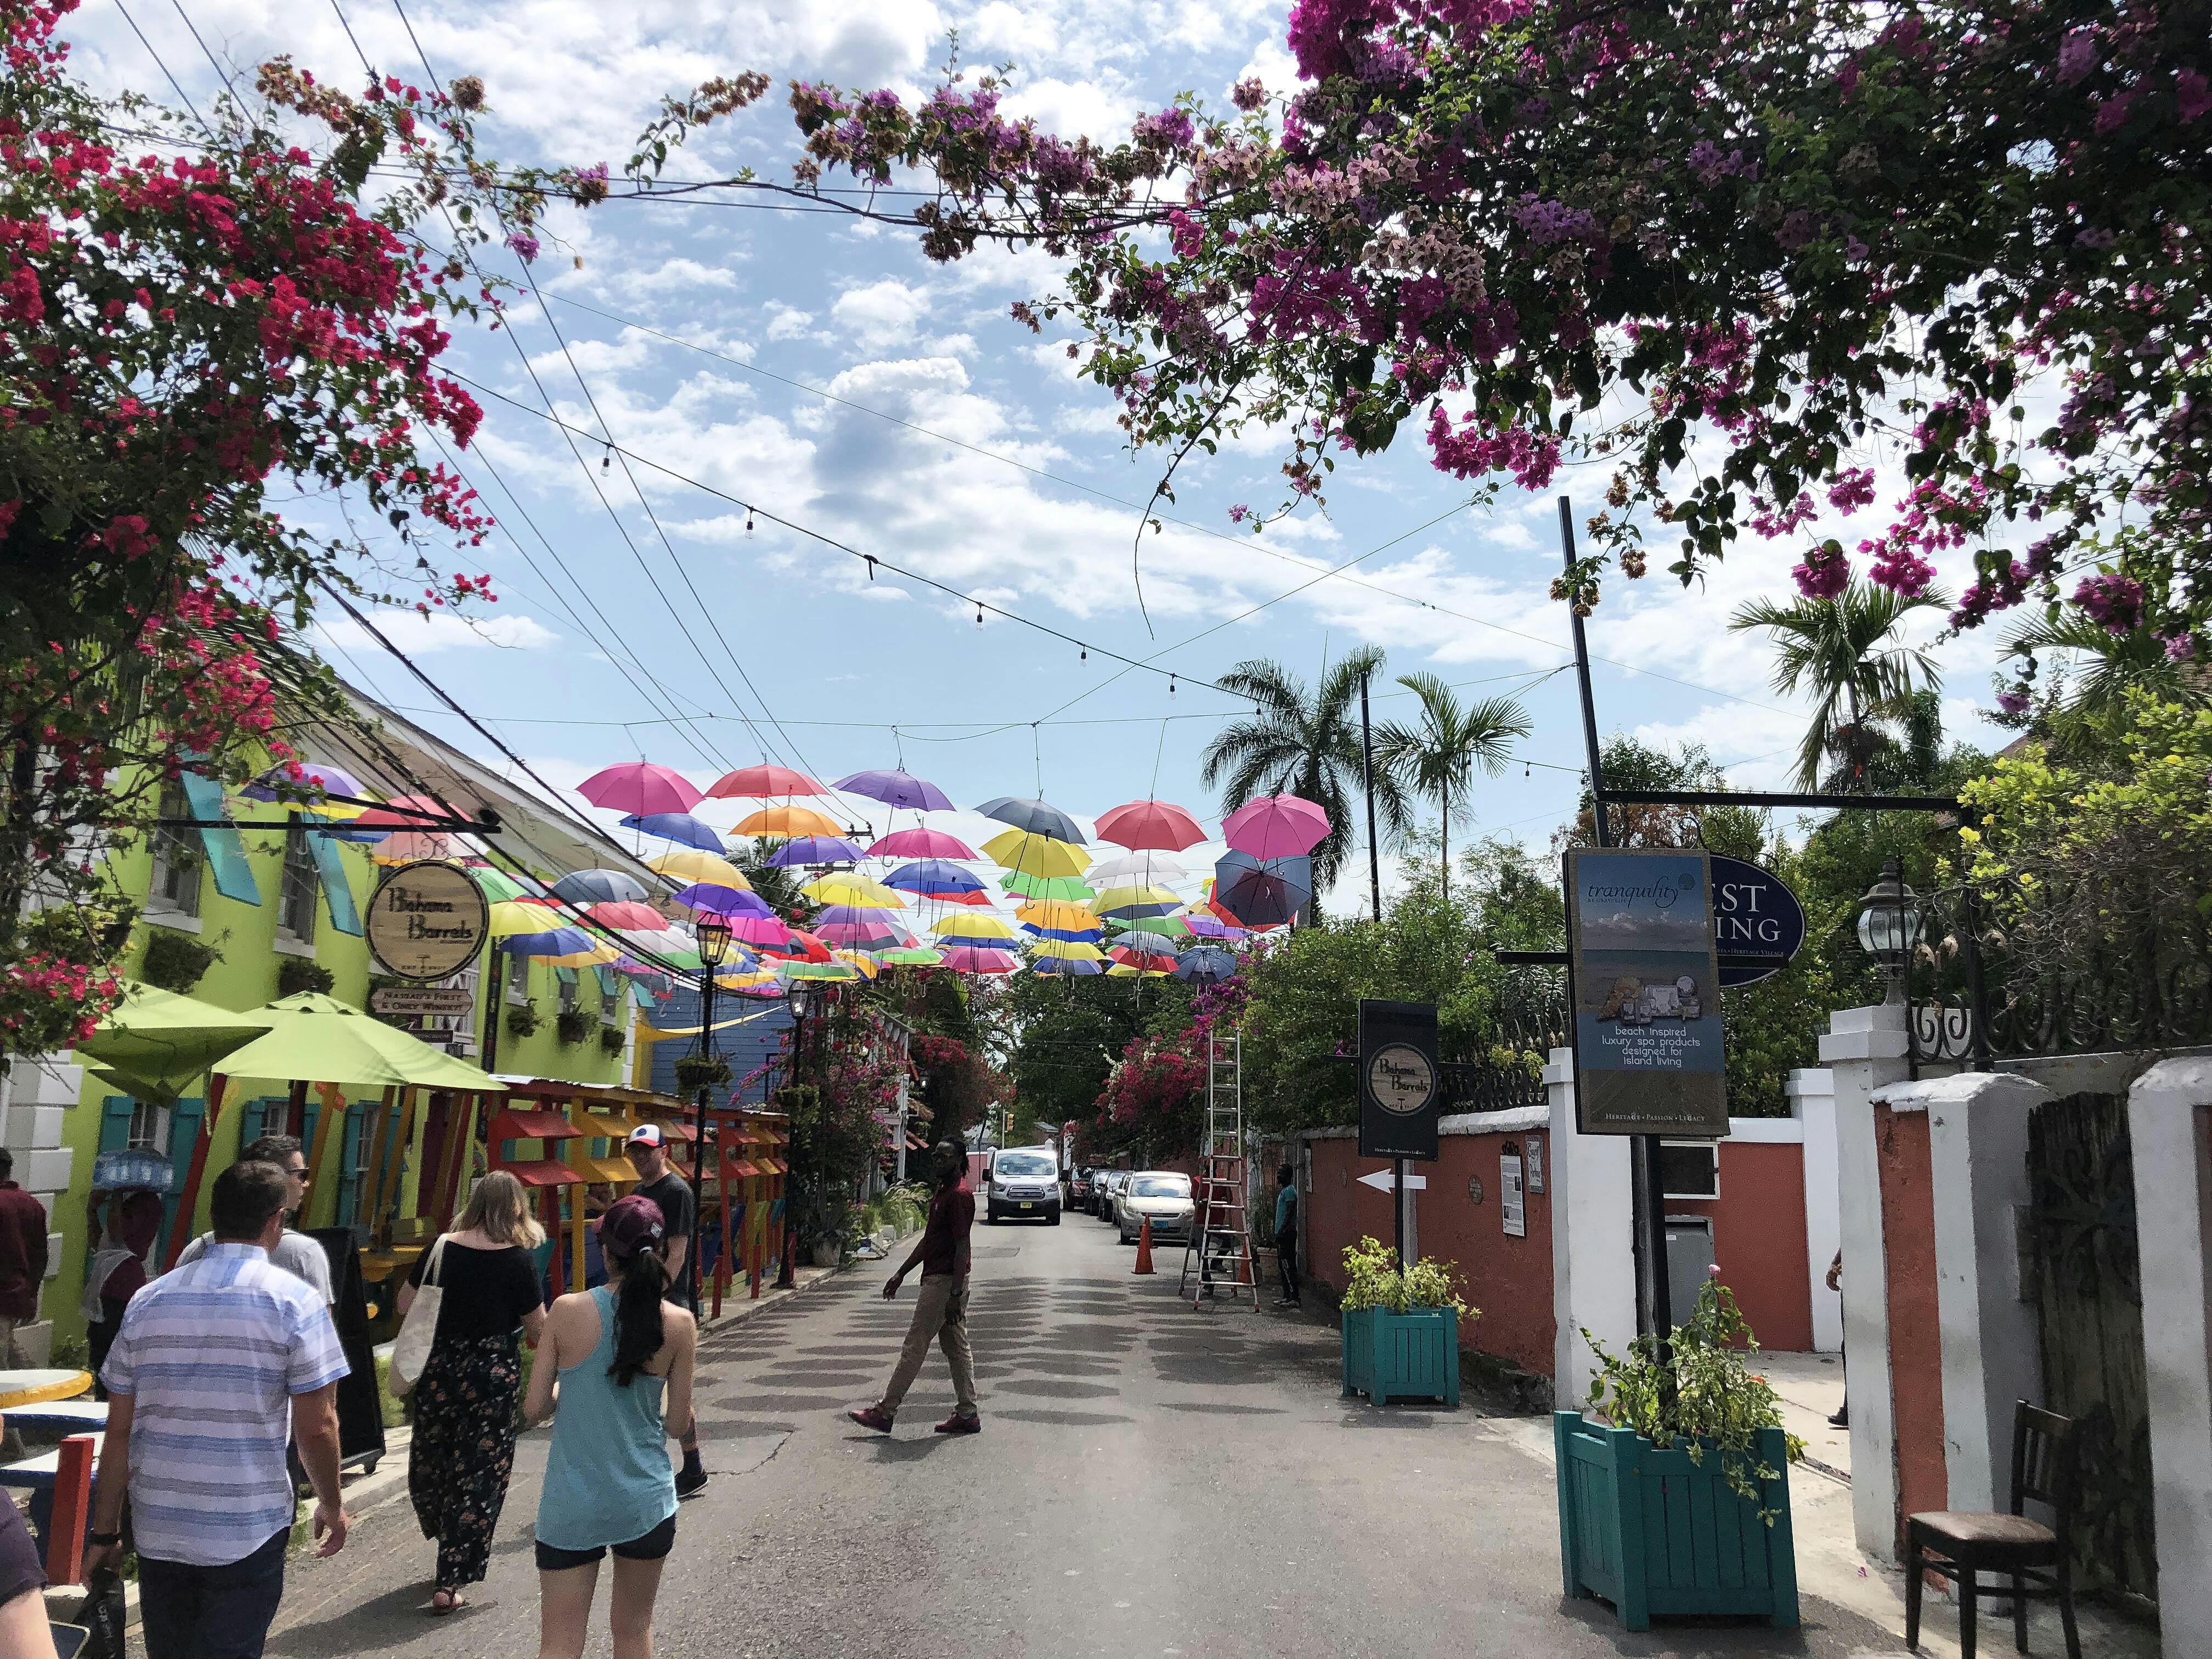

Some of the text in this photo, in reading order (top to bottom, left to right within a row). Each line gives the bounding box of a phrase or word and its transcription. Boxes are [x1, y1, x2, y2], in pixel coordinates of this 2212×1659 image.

[387, 887, 453, 912] Bahama
[1588, 876, 1679, 909] tranquility
[1712, 883, 1767, 912] ST
[406, 915, 474, 939] Barrels
[1714, 917, 1782, 942] ING
[1615, 1025, 1686, 1038] beach inspired
[1602, 1035, 1701, 1047] luxury spa products
[1622, 1045, 1683, 1057] designed for
[1379, 1058, 1416, 1075] Bahama
[1623, 1055, 1682, 1068] island living
[1391, 1075, 1427, 1092] Barrels
